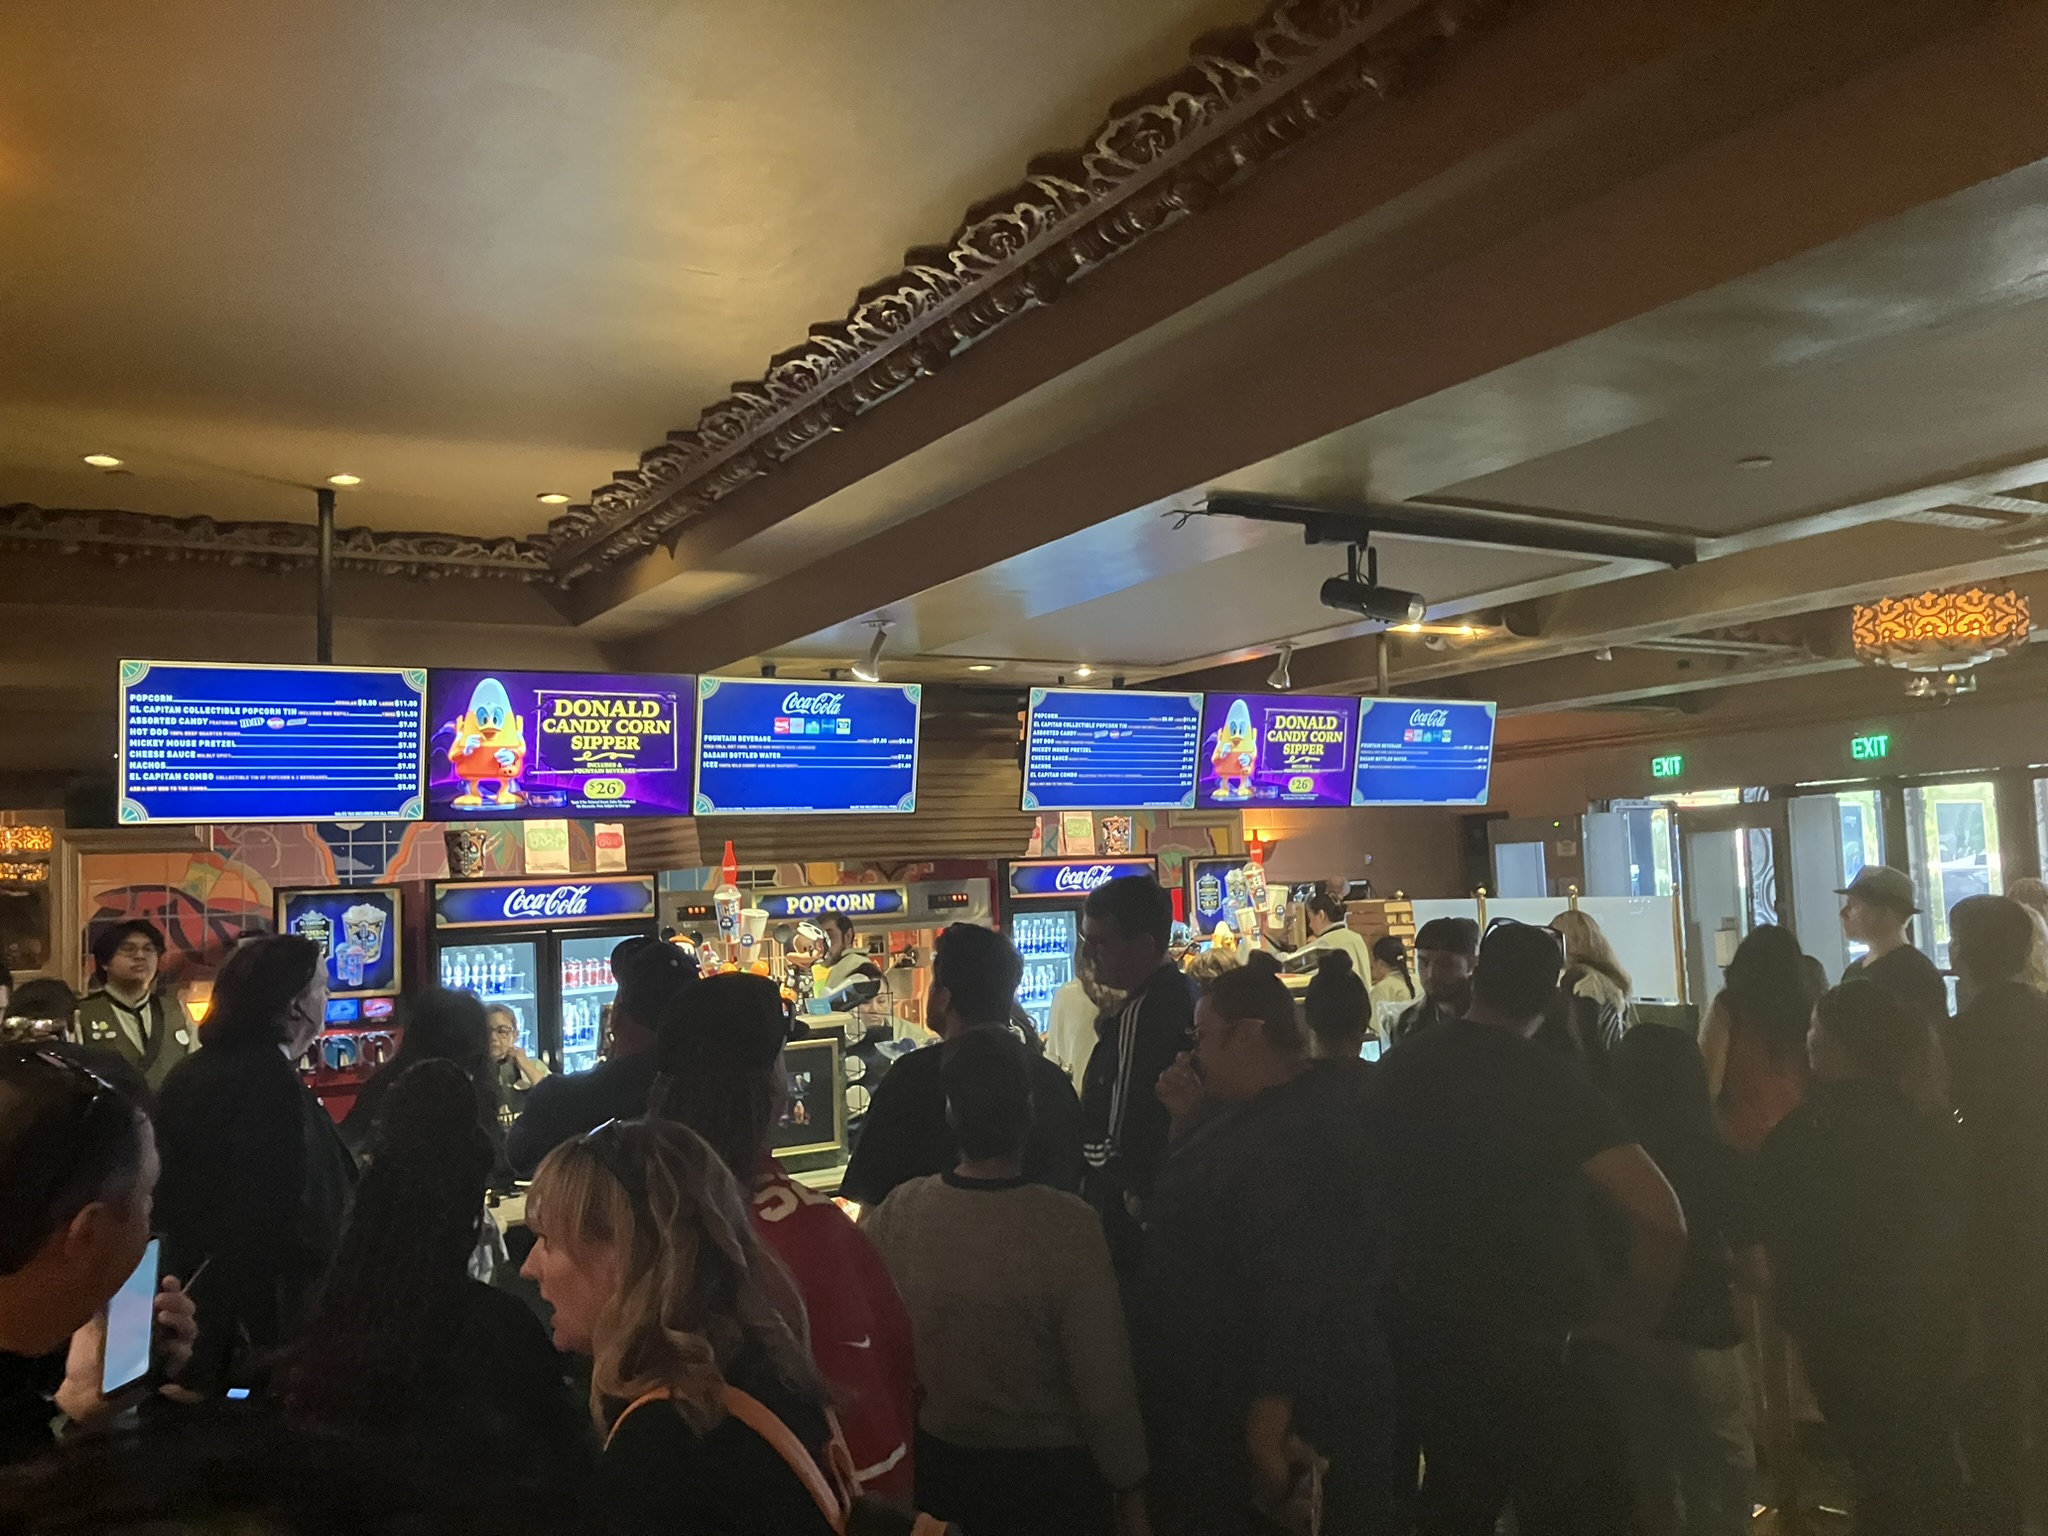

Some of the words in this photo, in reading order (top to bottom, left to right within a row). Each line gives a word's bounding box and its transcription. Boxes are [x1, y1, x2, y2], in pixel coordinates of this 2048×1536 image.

[130, 694, 173, 702] POPCORN
[782, 691, 845, 715] Coca-Cola
[130, 705, 142, 713] EL
[143, 705, 181, 714] CAPITAN
[183, 706, 240, 715] COLLECTIBLE
[242, 707, 282, 715] POPCORN
[283, 708, 297, 716] TIN
[553, 699, 660, 718] DONALD
[130, 716, 177, 725] ASSORTED
[178, 717, 209, 725] CANDY
[1274, 715, 1338, 730] DONALD
[1409, 708, 1449, 727] Coca-Cola
[130, 728, 149, 736] HOT
[150, 728, 169, 736] DOG
[542, 718, 612, 734] CANDY
[616, 719, 671, 734] CORN
[571, 735, 641, 750] SIPPER
[1267, 730, 1308, 742] CANDY
[1310, 731, 1343, 742] CORN
[129, 739, 165, 747] MICKEY
[166, 739, 197, 747] MOUSE
[199, 739, 237, 748] PRETZEL
[1283, 743, 1324, 755] SIPPER
[1852, 735, 1889, 759] EXIT
[129, 750, 164, 758] CHEESE
[166, 750, 196, 758] SAUCE
[129, 761, 167, 769] NACHOS
[1652, 756, 1682, 777] EXIT
[143, 772, 182, 780] CAPITAN
[183, 772, 214, 780] COMBO
[503, 885, 592, 918] Coca-Cola
[786, 893, 876, 914] POPCORN
